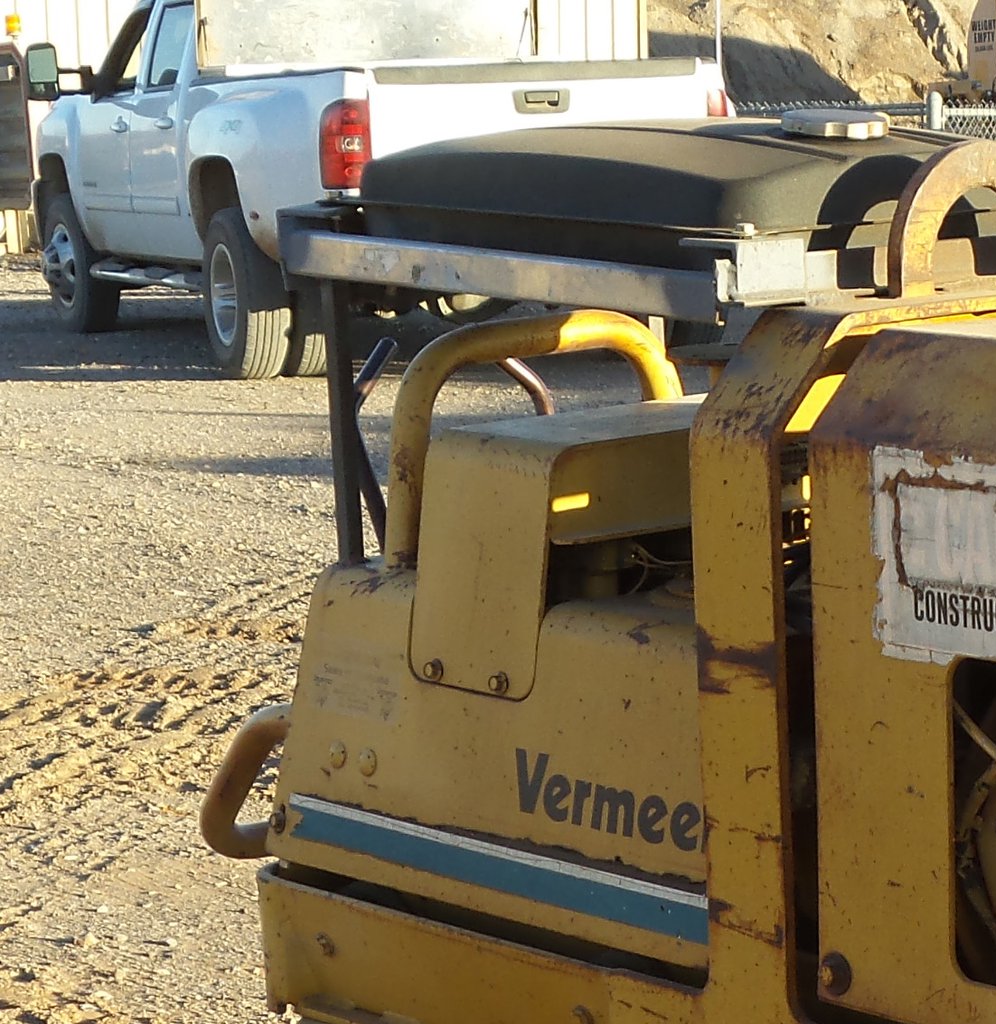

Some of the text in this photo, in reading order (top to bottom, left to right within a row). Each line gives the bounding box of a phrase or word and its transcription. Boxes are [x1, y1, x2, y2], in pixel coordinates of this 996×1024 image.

[971, 19, 996, 31] WEIGHT
[974, 31, 994, 43] EMPTY
[516, 748, 707, 853] Vermee
